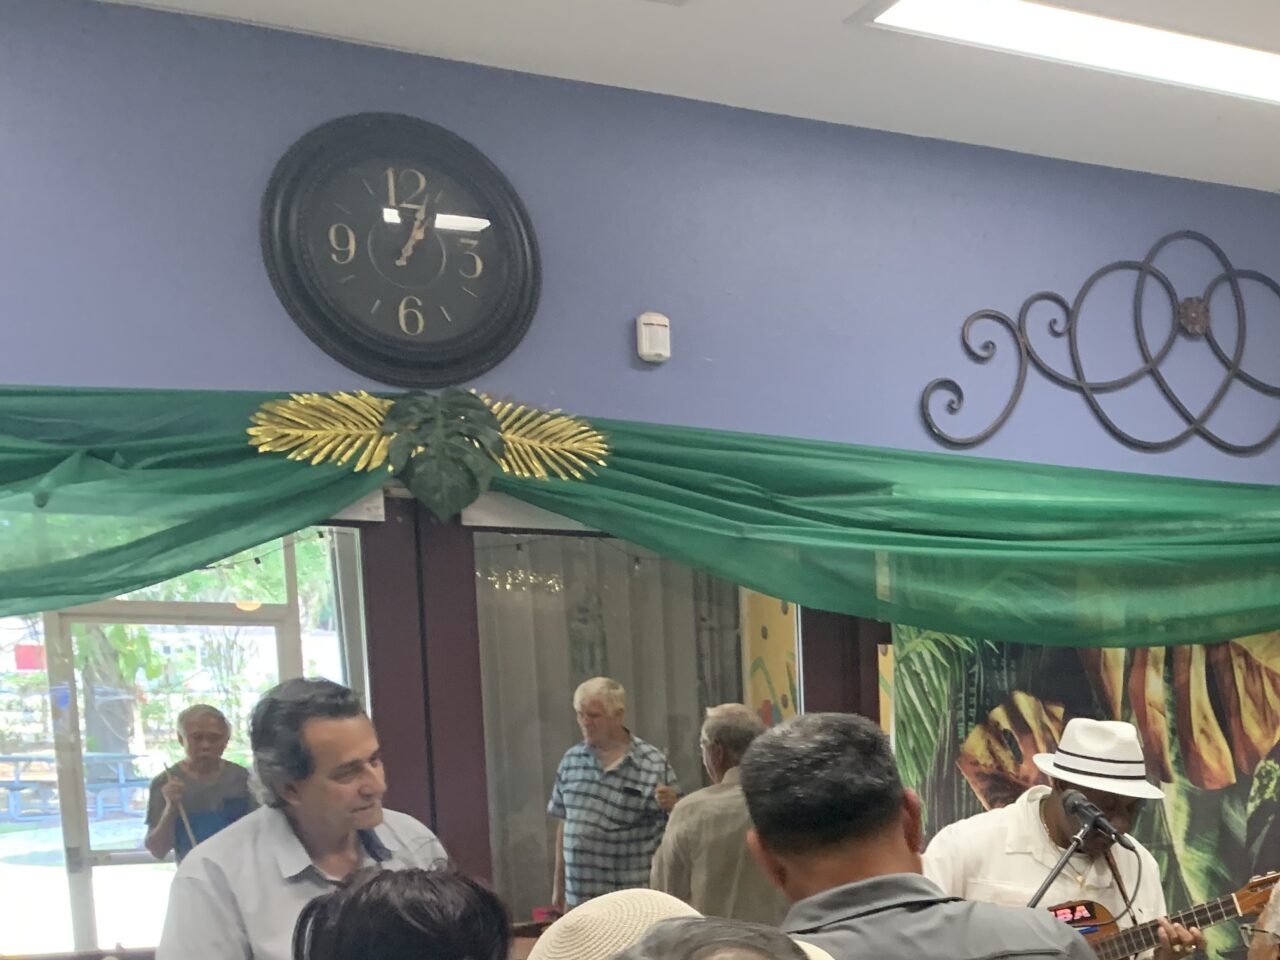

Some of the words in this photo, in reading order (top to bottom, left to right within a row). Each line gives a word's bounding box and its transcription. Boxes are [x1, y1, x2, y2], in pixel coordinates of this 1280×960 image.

[386, 167, 427, 209] 12
[328, 223, 357, 264] 9
[398, 295, 425, 336] 6
[1052, 905, 1091, 921] BA
